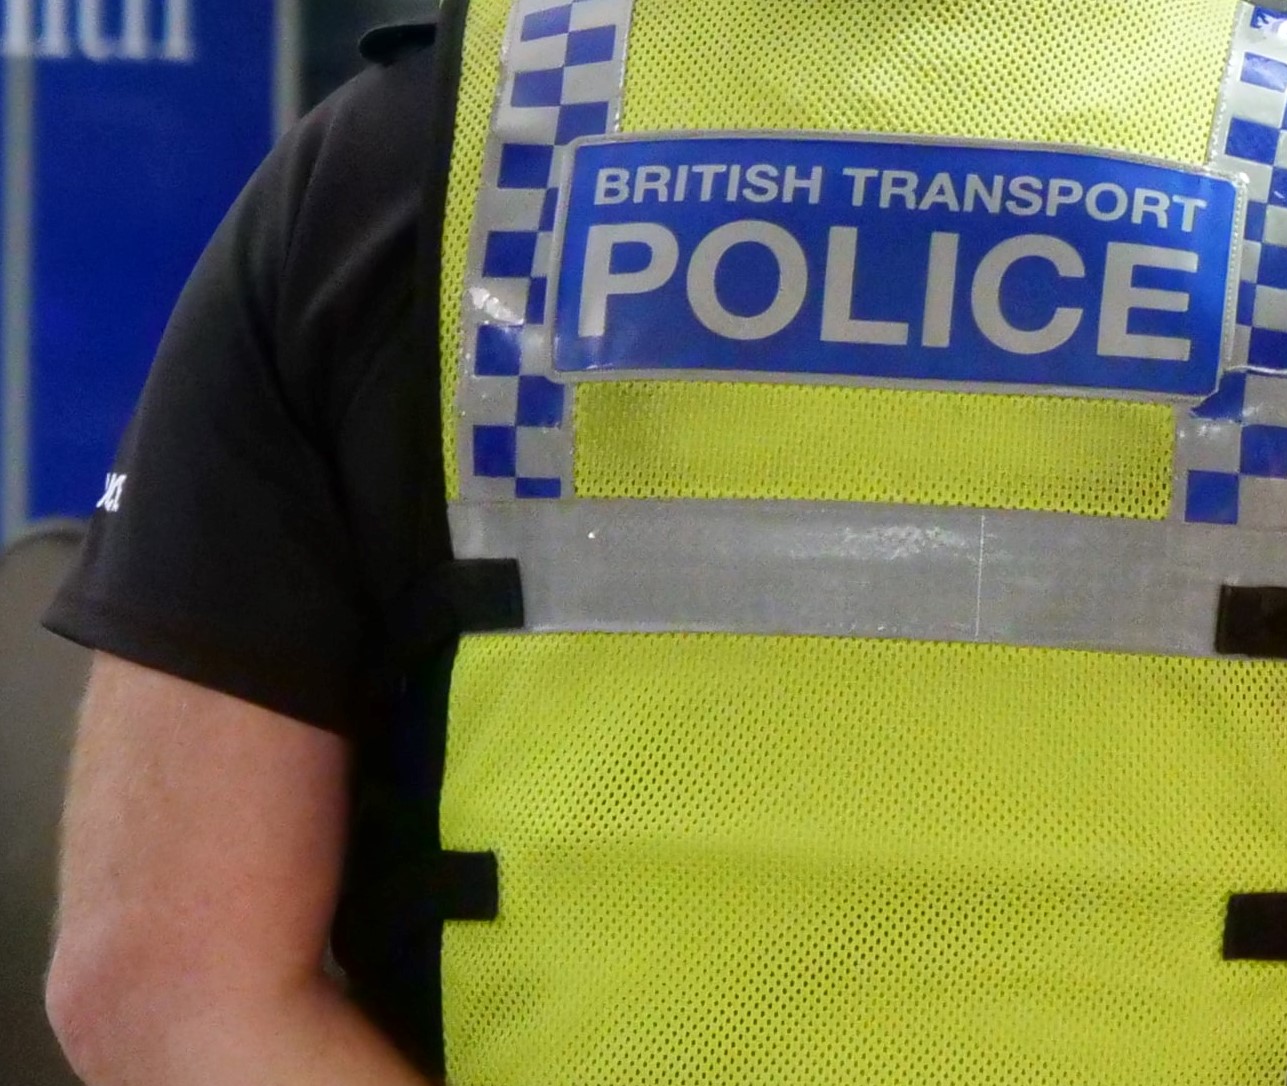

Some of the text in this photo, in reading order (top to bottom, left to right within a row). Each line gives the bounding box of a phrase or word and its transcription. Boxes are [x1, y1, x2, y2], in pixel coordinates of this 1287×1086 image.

[593, 163, 1207, 233] BRITISH TRANSPORT
[577, 219, 1200, 363] POLICE
